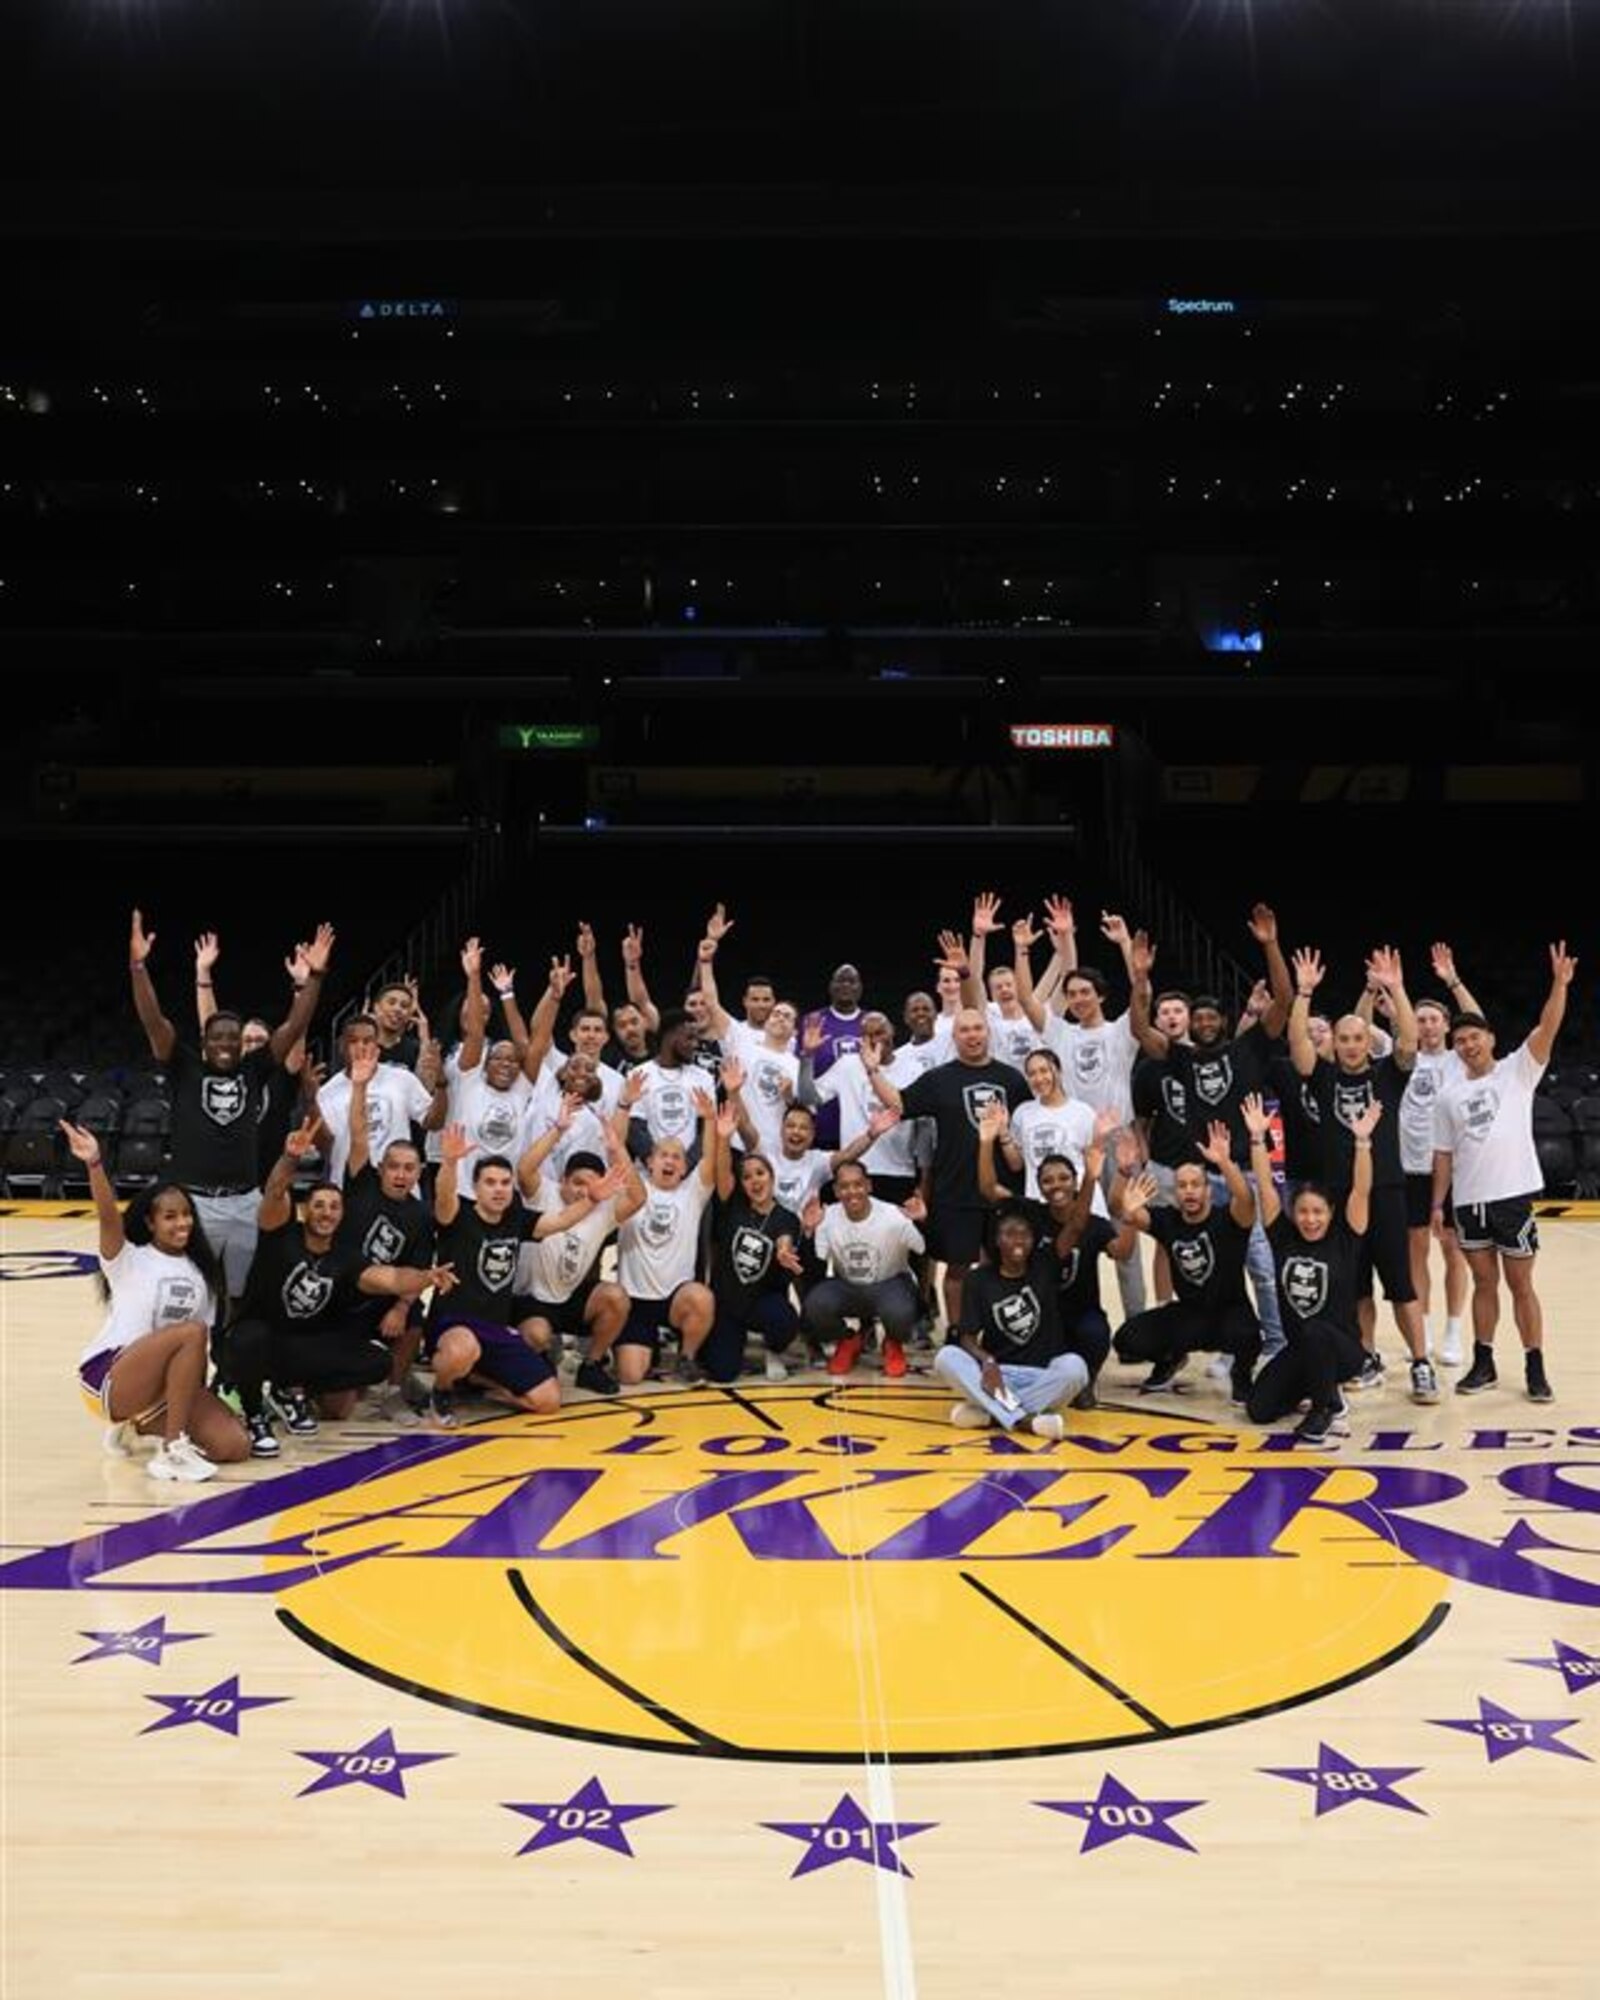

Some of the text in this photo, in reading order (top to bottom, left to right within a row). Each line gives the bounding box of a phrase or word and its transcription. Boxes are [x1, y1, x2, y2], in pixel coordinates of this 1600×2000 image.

[380, 303, 444, 316] DELTA
[1168, 299, 1234, 314] Spectrum
[1010, 728, 1112, 746] TOSHIBA
[592, 1434, 887, 1456] LOS
[183, 1699, 234, 1716] '10
[1473, 1722, 1534, 1741] '87
[335, 1755, 397, 1775] '09
[1308, 1772, 1379, 1792] '88
[546, 1808, 614, 1831] '02
[1085, 1804, 1154, 1827] '00
[811, 1827, 873, 1849] '01
